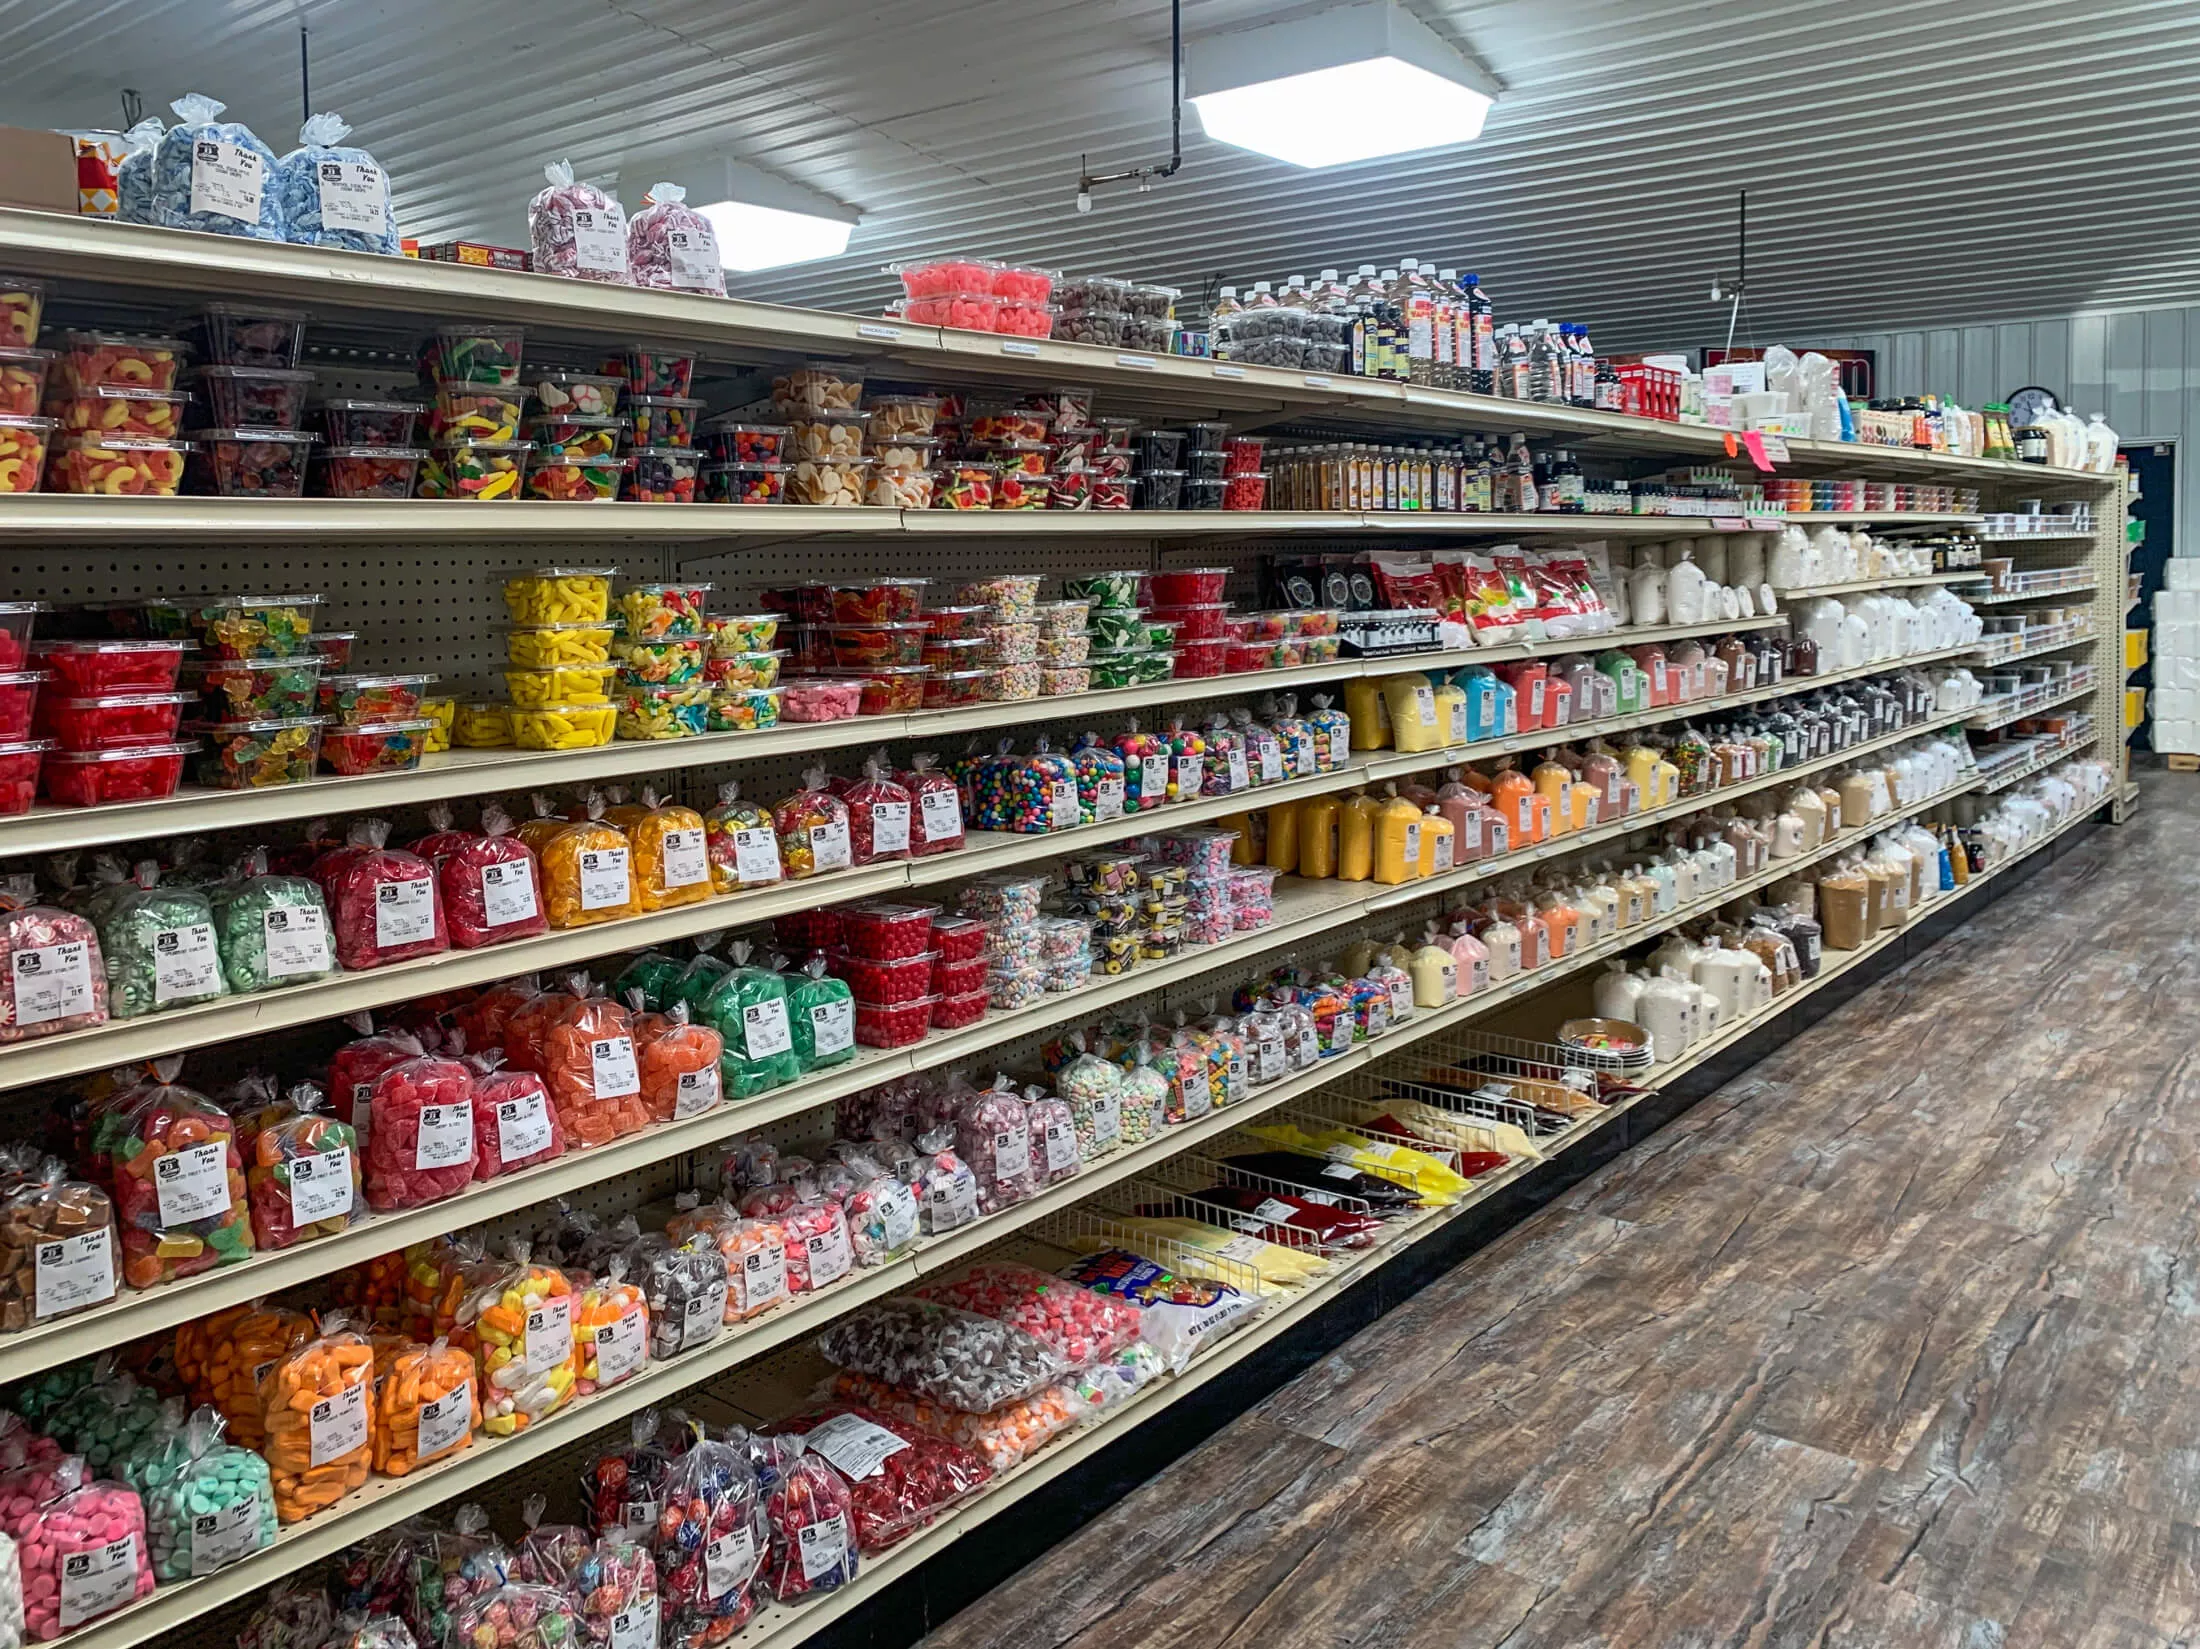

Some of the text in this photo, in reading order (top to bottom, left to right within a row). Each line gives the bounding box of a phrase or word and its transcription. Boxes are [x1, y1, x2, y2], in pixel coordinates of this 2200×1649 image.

[235, 148, 256, 162] Thank
[240, 160, 252, 168] You
[356, 166, 378, 176] Thank
[363, 174, 375, 182] You
[411, 881, 429, 889] Thank
[192, 926, 208, 935] Thank
[57, 945, 81, 955] Thank
[65, 955, 78, 963] You
[452, 1104, 469, 1113] Thank
[194, 1146, 218, 1159] Thank
[325, 1150, 345, 1162] Thank
[201, 1156, 215, 1166] You
[330, 1160, 341, 1168] You
[80, 1230, 106, 1245] Thank
[87, 1243, 101, 1253] You
[343, 1385, 361, 1400] Thank
[232, 1496, 254, 1514] Thank
[106, 1539, 130, 1554] Thank
[112, 1551, 127, 1561] You
